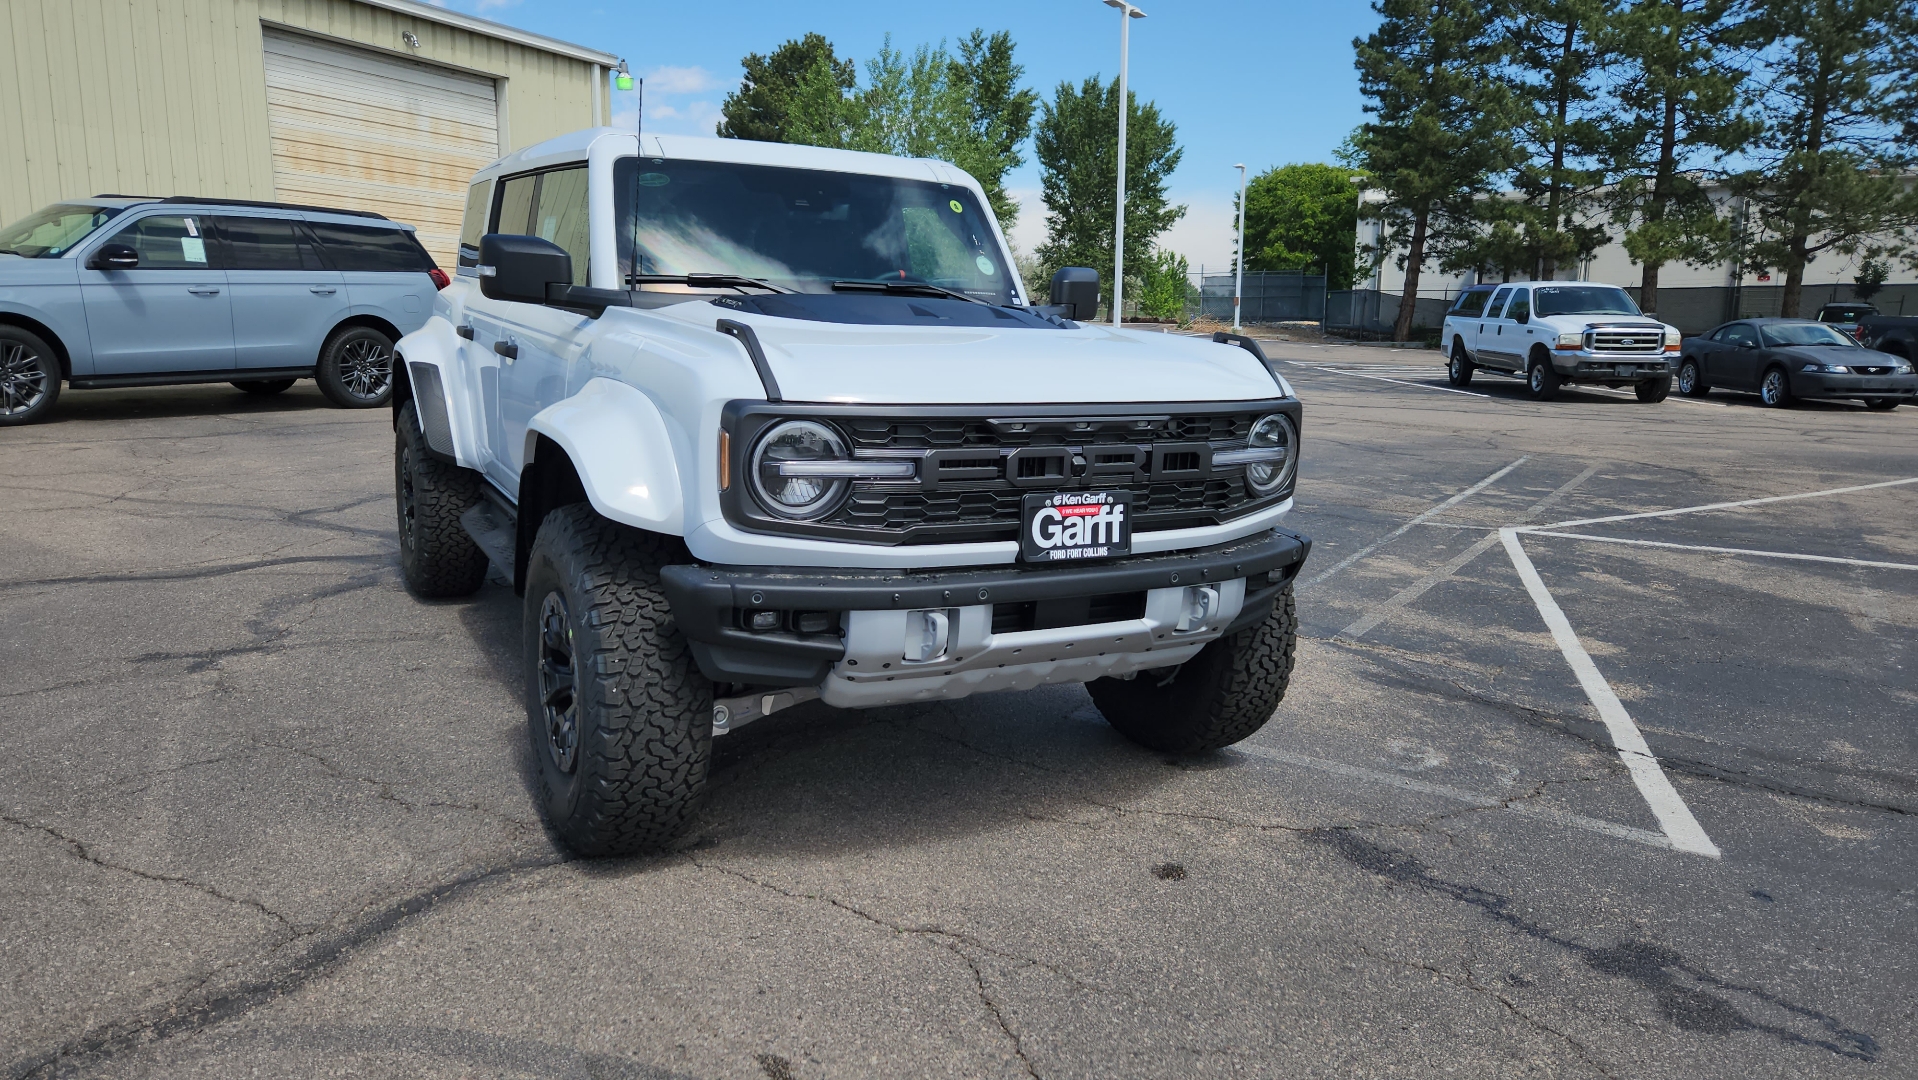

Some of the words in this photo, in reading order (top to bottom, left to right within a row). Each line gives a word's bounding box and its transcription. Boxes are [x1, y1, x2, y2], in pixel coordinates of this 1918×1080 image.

[921, 442, 1212, 491] FORD
[1062, 494, 1081, 505] Ken
[1082, 492, 1107, 504] Garff
[1031, 504, 1124, 549] Garff
[1050, 549, 1066, 559] FORD
[1067, 548, 1082, 558] FORT
[1083, 547, 1108, 557] COLLINS
